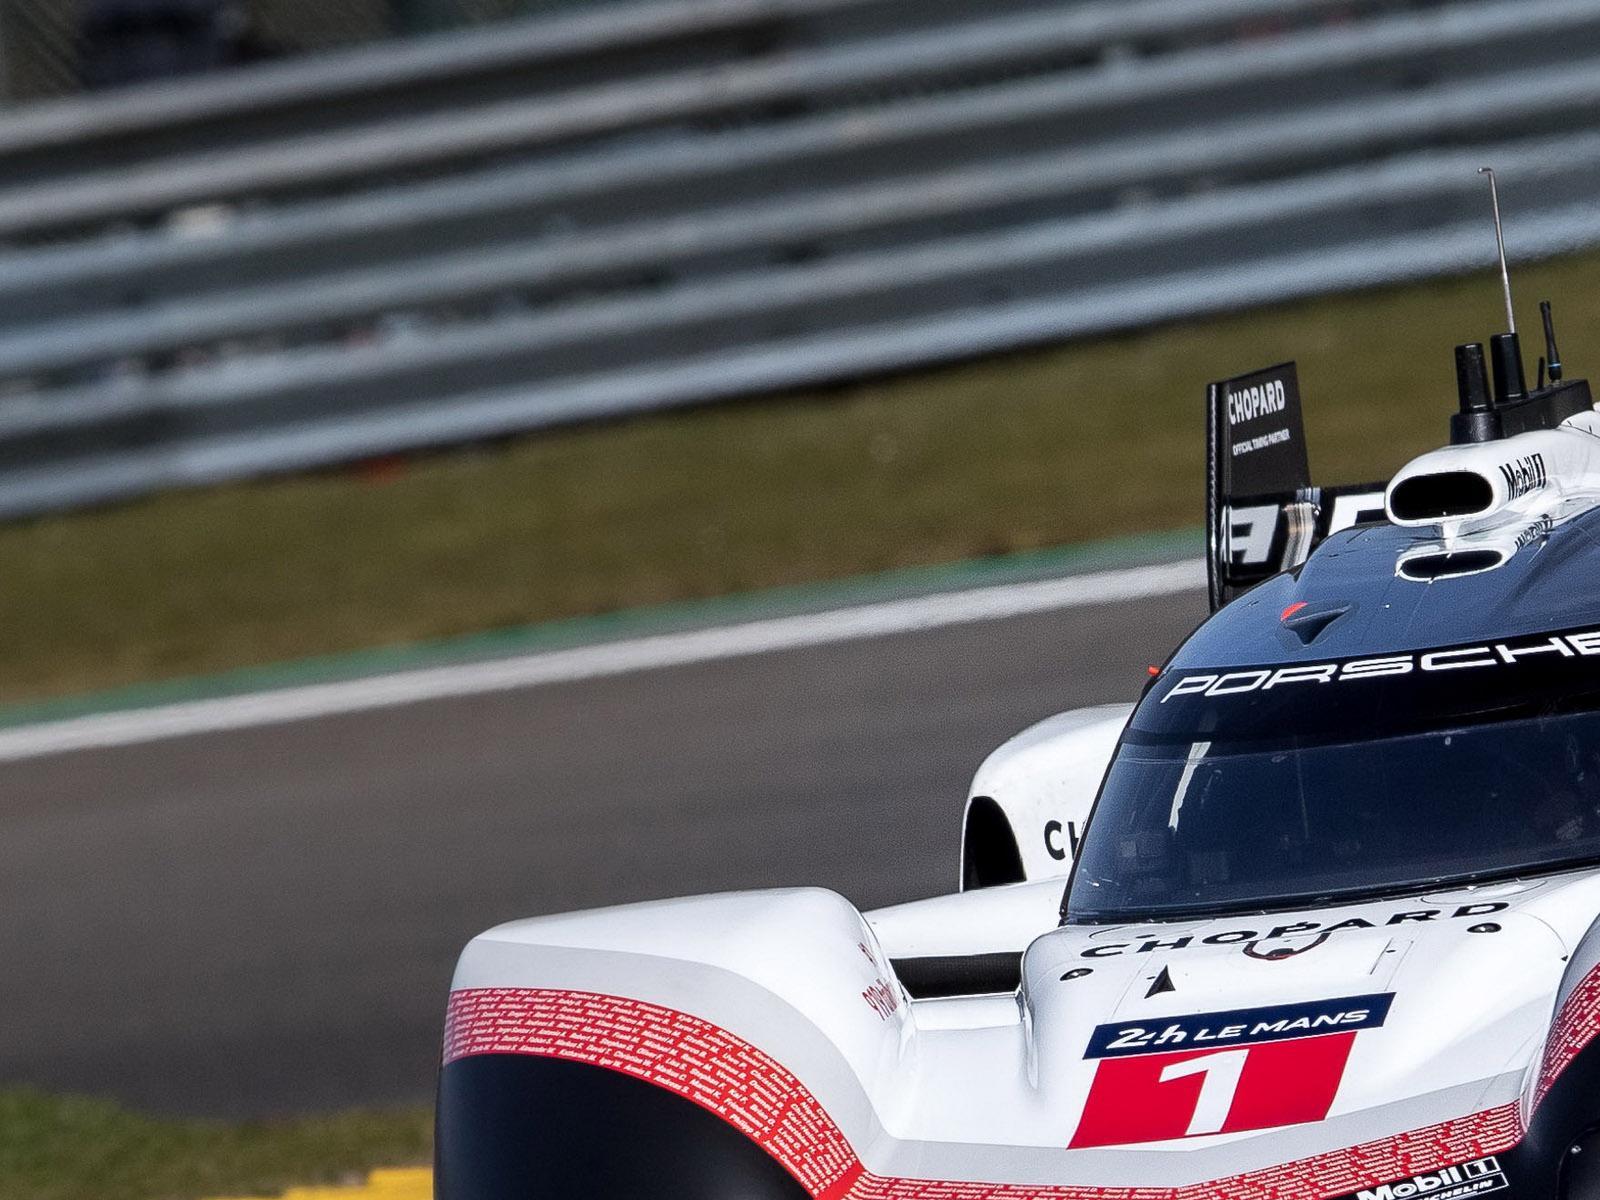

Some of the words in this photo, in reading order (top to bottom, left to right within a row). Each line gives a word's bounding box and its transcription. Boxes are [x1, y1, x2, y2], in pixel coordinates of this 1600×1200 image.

[1228, 379, 1286, 425] CHOPARD
[1499, 456, 1537, 501] Mobil
[1080, 902, 1510, 958] CHOPARD
[1193, 1025, 1247, 1041] LE
[1249, 1009, 1370, 1035] MANS
[1158, 1048, 1250, 1136] 1
